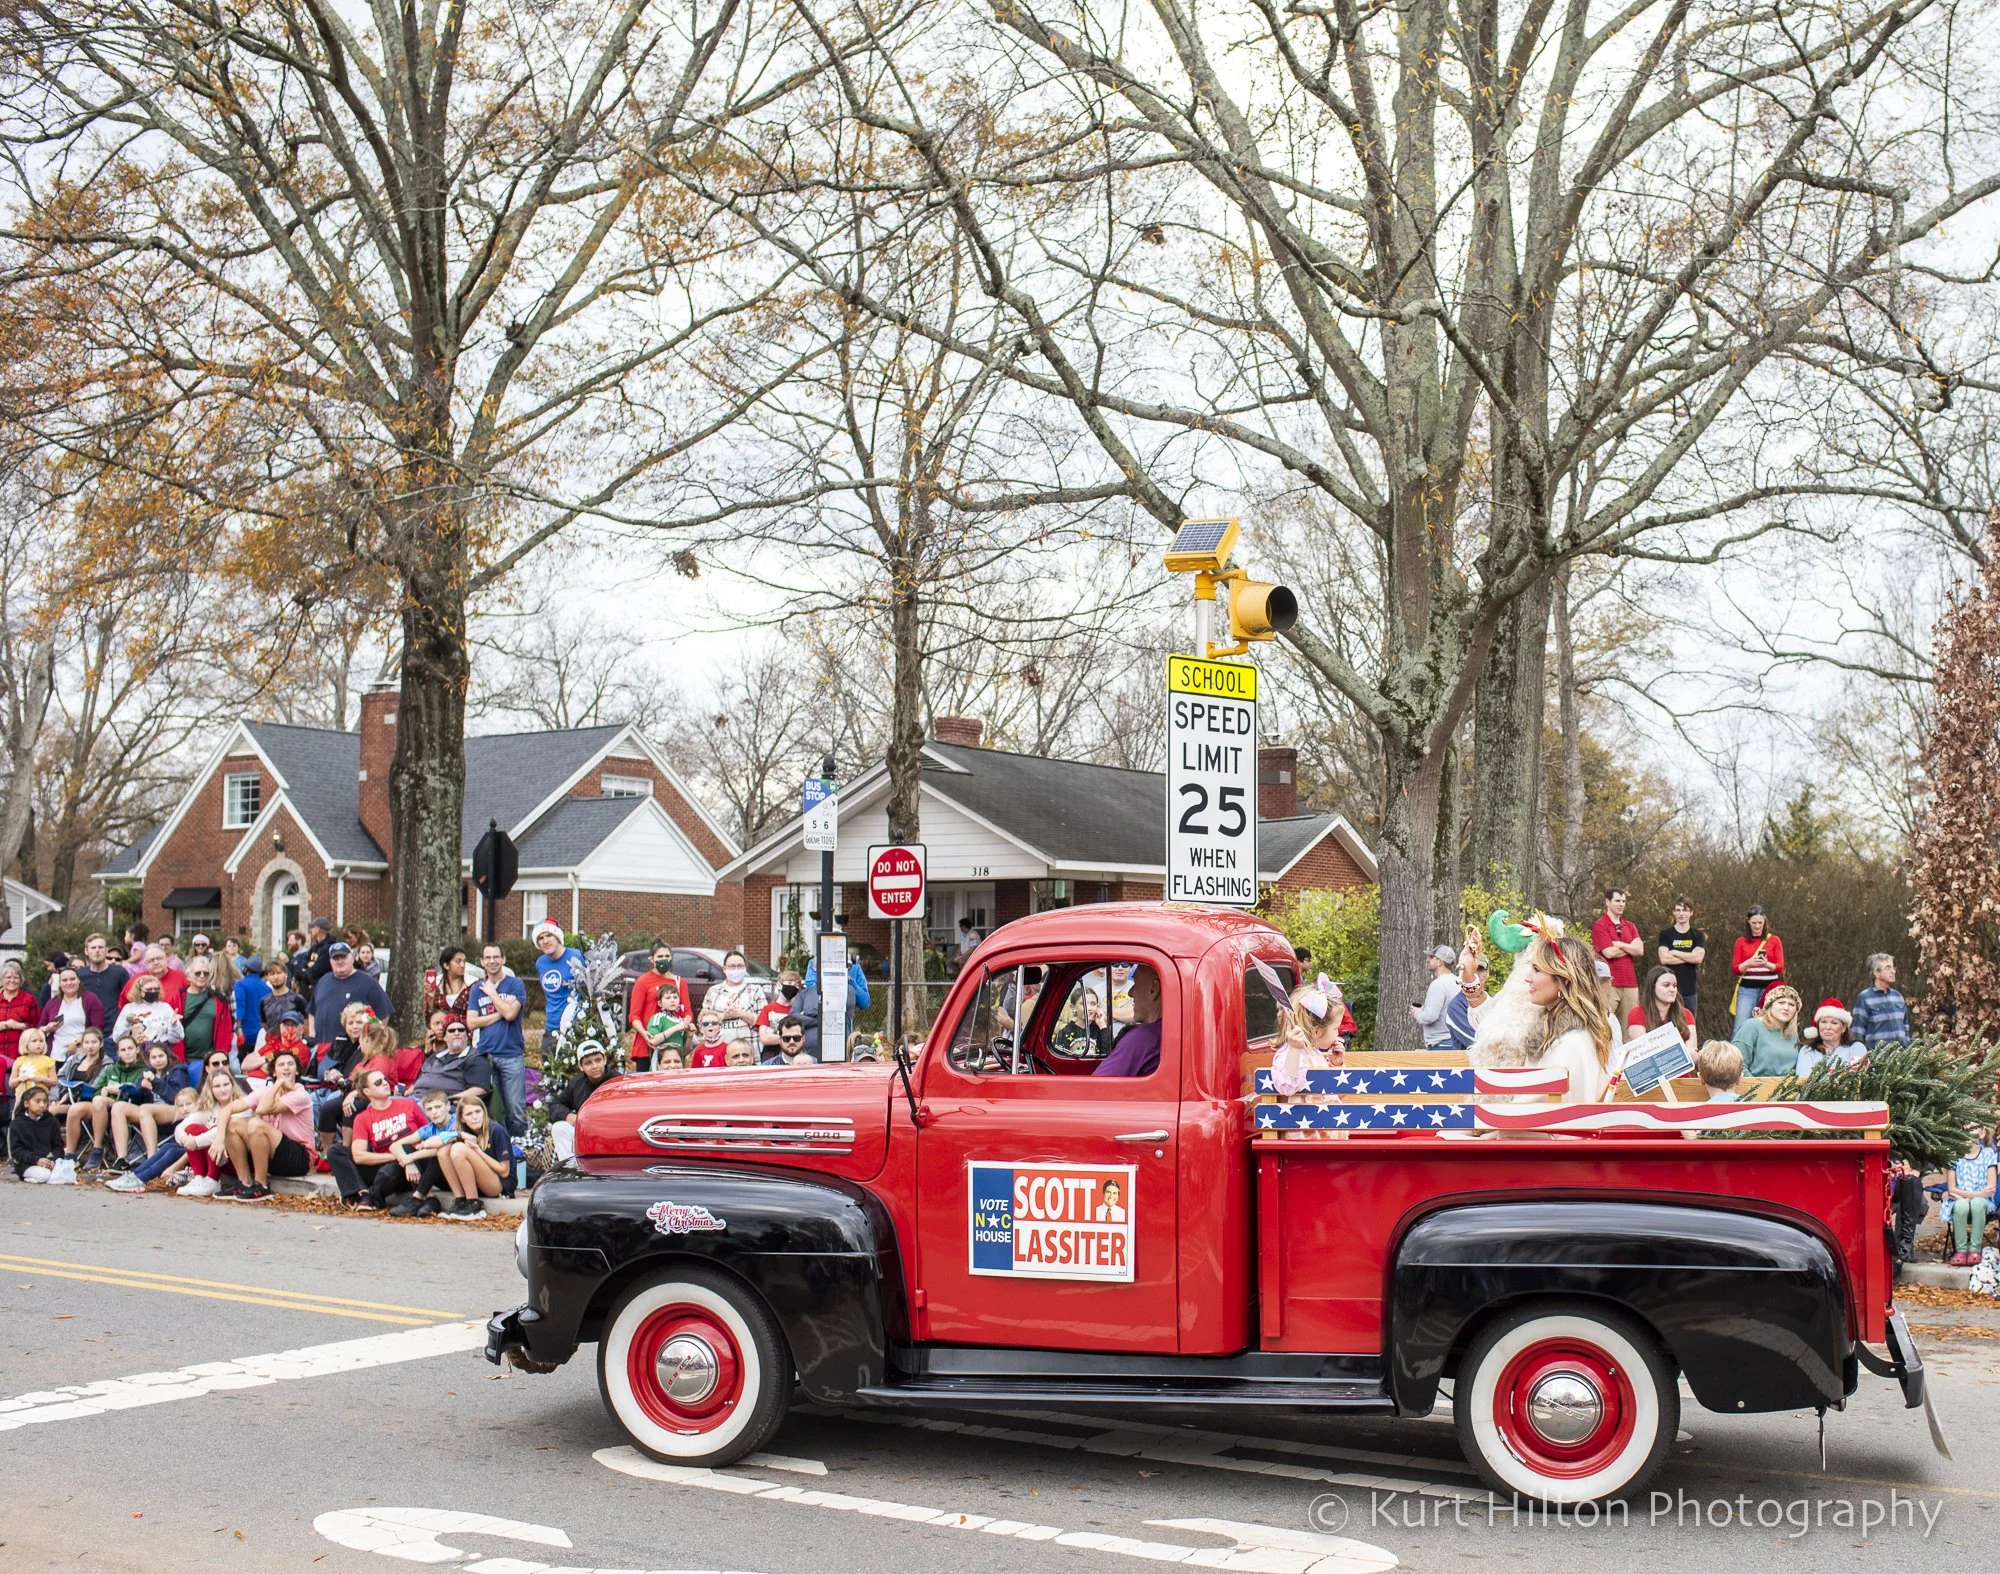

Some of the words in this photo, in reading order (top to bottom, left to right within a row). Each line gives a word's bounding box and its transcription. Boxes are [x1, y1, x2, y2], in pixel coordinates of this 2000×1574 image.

[1181, 664, 1246, 694] SCHOOL
[1174, 700, 1251, 736] SPEED
[1182, 742, 1242, 775] LIMIT
[805, 781, 822, 791] BUS
[805, 790, 826, 801] STOP
[1178, 783, 1247, 838] 25
[812, 820, 817, 829] 5
[823, 820, 829, 830] 6
[1189, 847, 1237, 869] WHEN
[877, 861, 891, 874] DO
[896, 860, 916, 872] NOT
[971, 866, 990, 877] 318
[1173, 875, 1252, 898] FLASHING
[881, 891, 912, 904] ENTER
[803, 1131, 841, 1139] FORD
[979, 1198, 1009, 1211] VOTE
[1013, 1175, 1097, 1221] SCOTT
[650, 1204, 691, 1220] Merry
[669, 1215, 720, 1229] Christmas
[975, 1230, 1012, 1243] HOUSE
[1014, 1228, 1126, 1267] LASSITER
